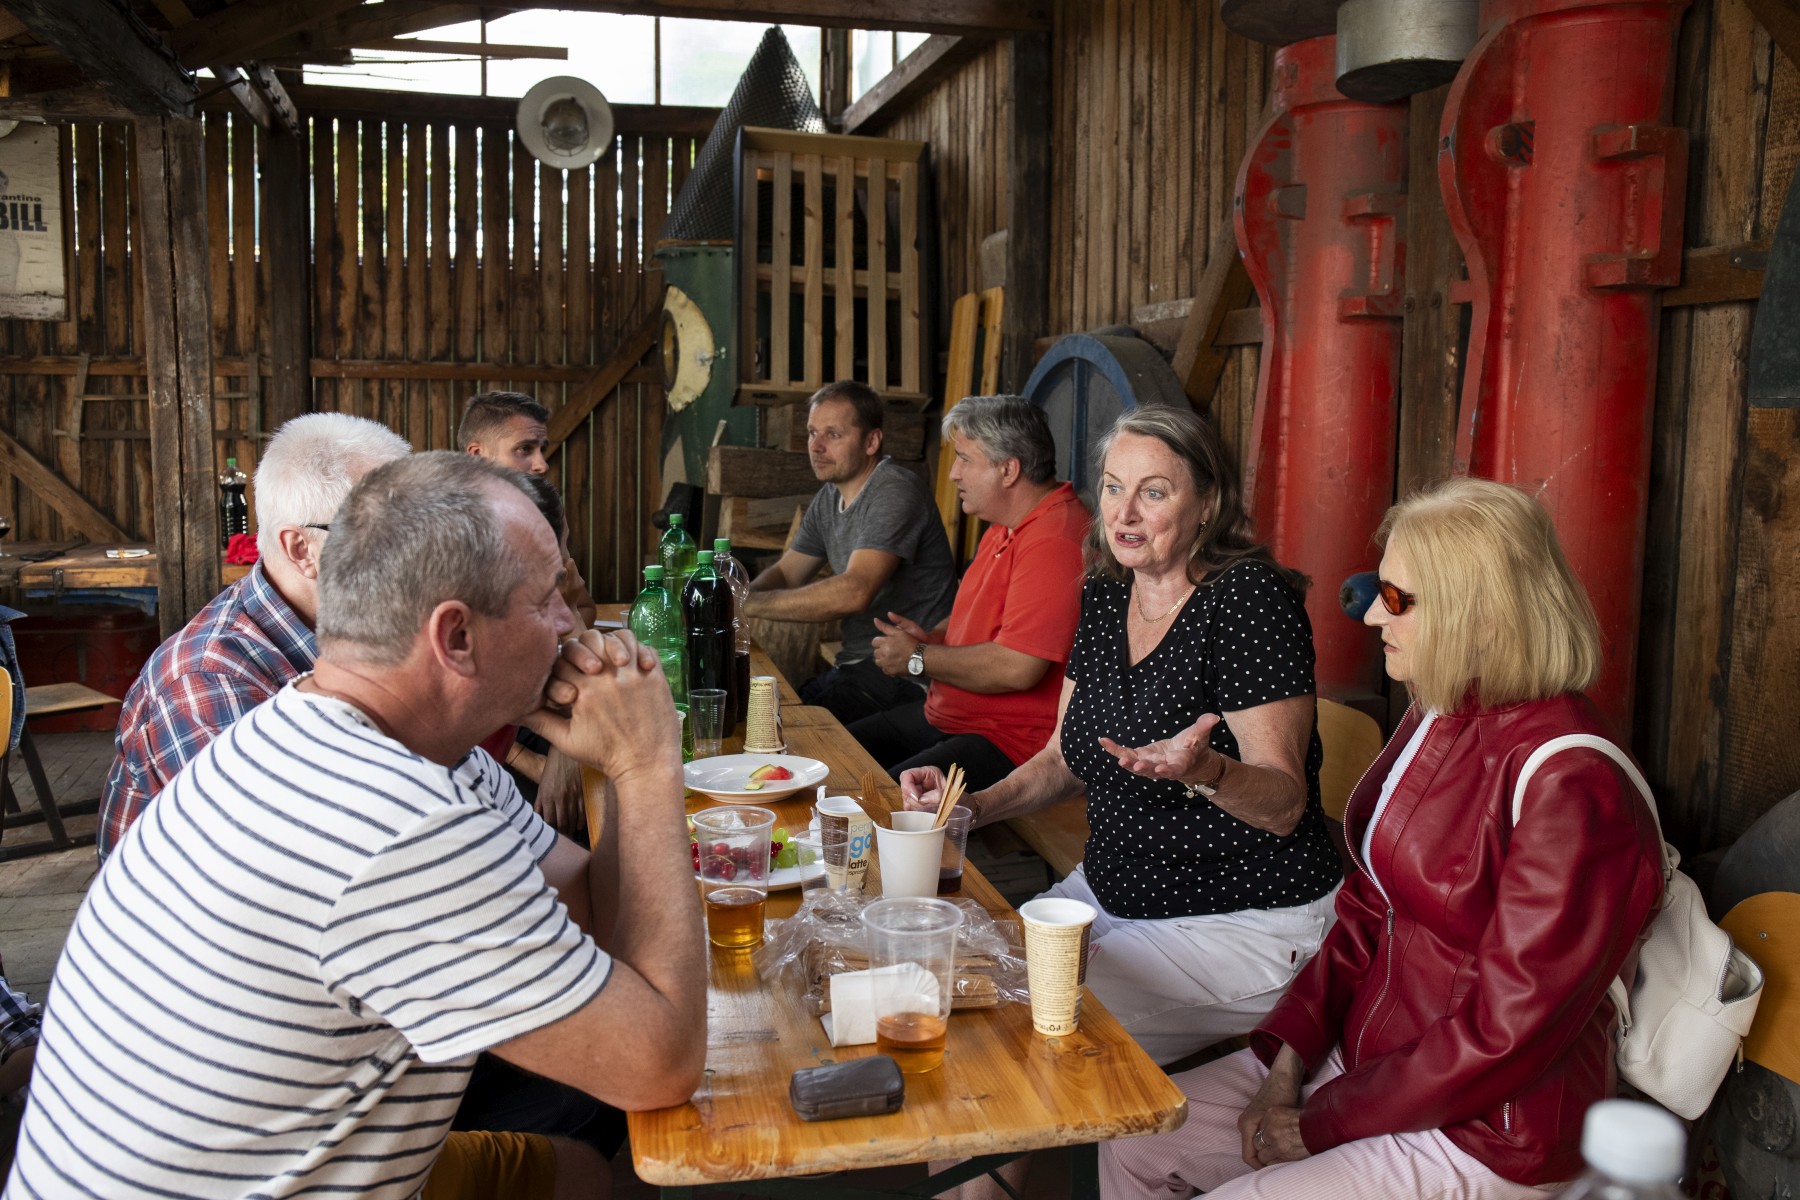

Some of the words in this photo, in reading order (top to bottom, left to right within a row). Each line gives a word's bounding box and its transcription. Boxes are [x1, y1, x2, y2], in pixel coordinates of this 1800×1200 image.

[0, 194, 42, 202] antino
[0, 202, 48, 232] BILL
[848, 858, 868, 870] latte
